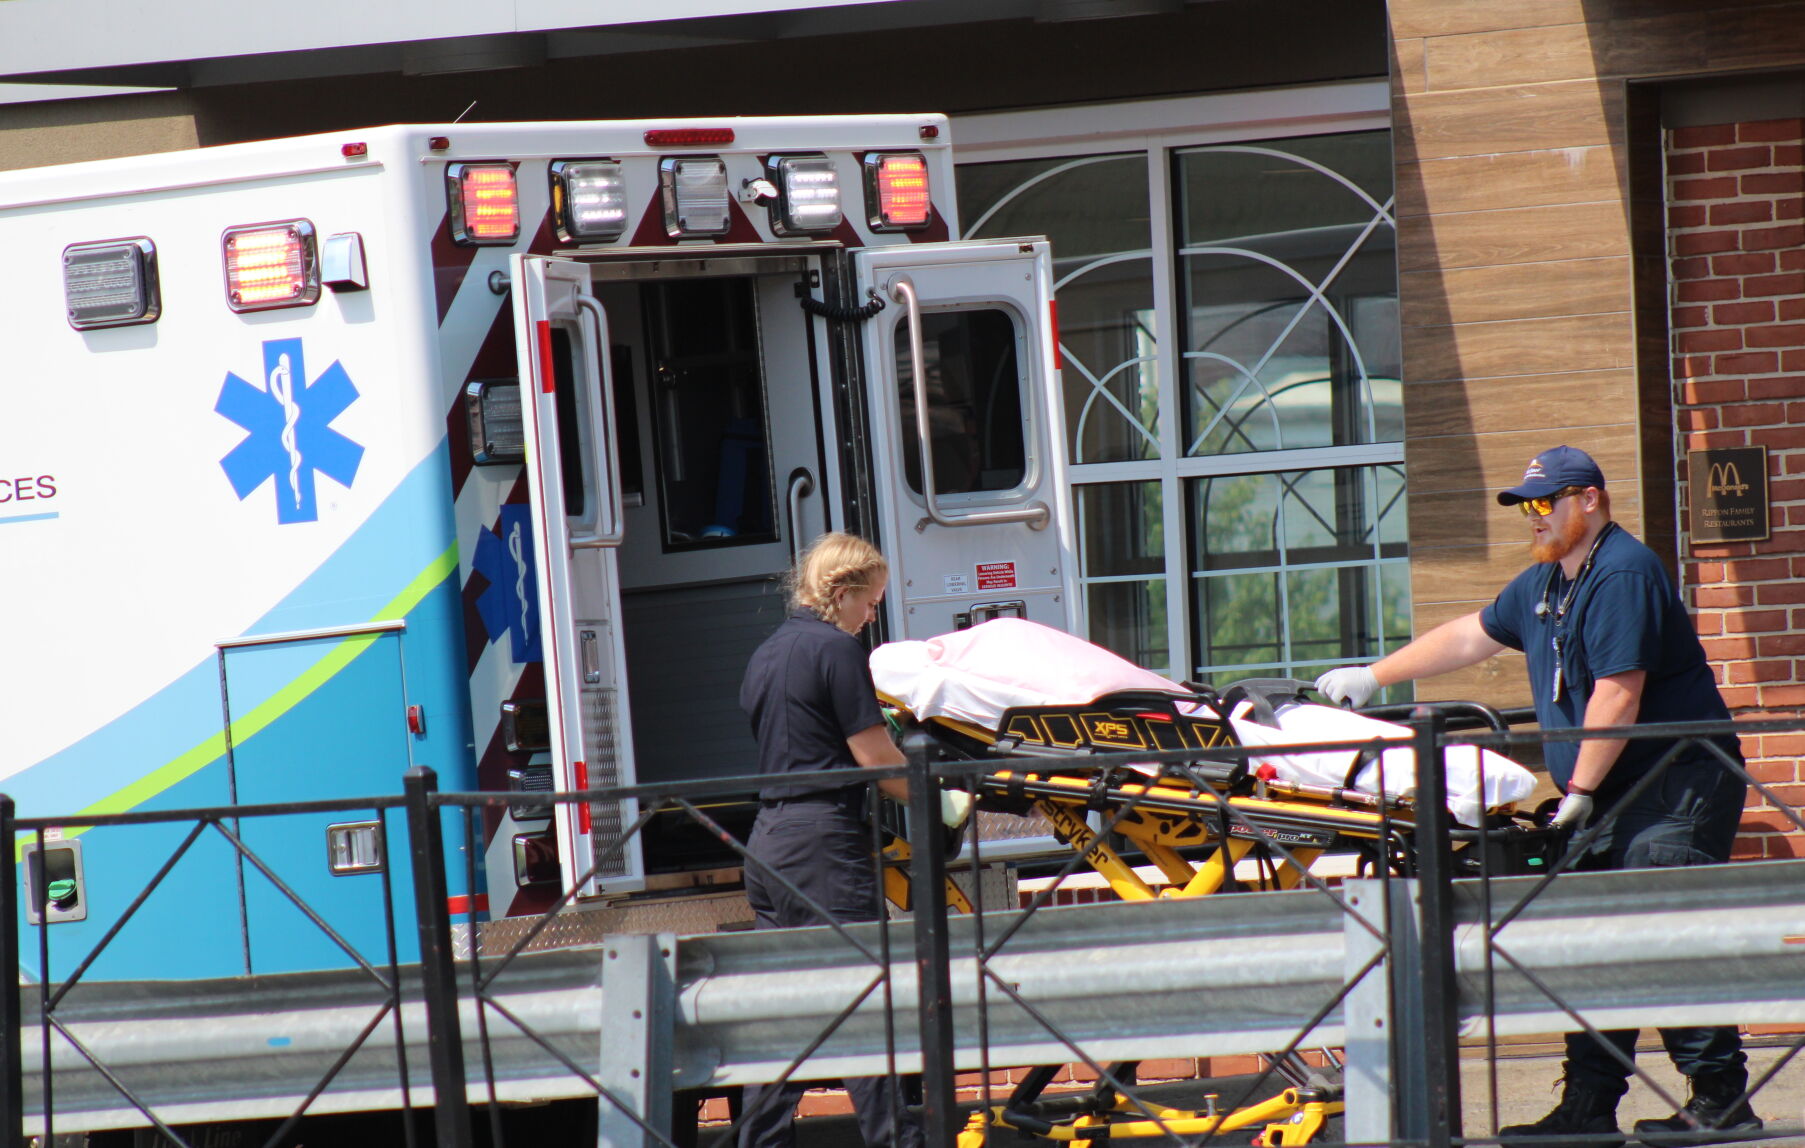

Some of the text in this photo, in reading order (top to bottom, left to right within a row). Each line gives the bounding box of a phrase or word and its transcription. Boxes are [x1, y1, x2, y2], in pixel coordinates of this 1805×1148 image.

[1703, 518, 1754, 528] RESTAURANTS
[1094, 721, 1129, 739] XPS
[1040, 800, 1109, 864] stryker
